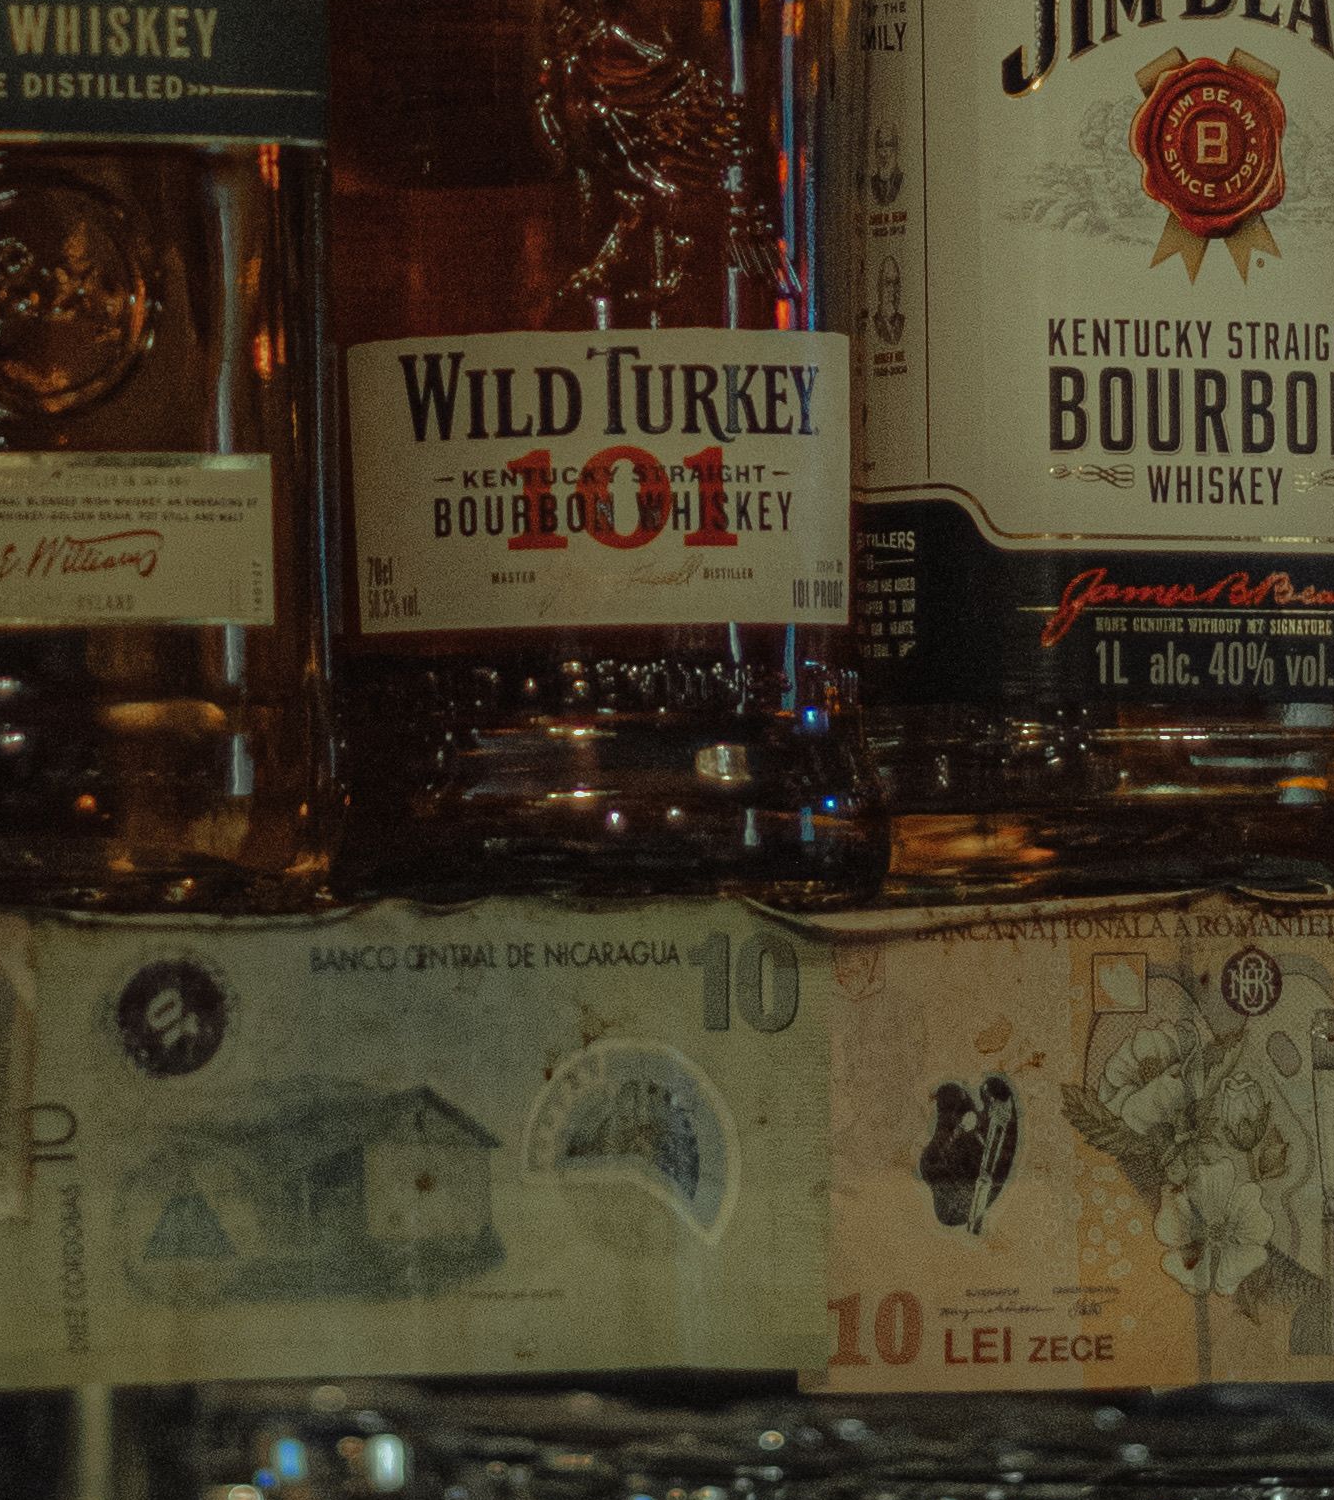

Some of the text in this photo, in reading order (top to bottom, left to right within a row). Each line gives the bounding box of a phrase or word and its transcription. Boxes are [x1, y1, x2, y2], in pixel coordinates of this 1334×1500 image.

[7, 3, 220, 61] WHISKEY
[22, 73, 185, 101] DISTILLED
[1166, 86, 1259, 133] JIM BEAM
[1165, 147, 1261, 199] SINCE 1795
[1046, 317, 1213, 360] KENTUCKY
[398, 345, 821, 444] WILD TURKEY
[462, 463, 767, 488] KENTUCKY STRAIGHT
[505, 444, 739, 551] 101
[1146, 463, 1285, 507] WHISKEY
[433, 491, 794, 538] BOURBON WHISKEY
[1187, 617, 1242, 636] WITHOUT
[1268, 618, 1334, 637] SIGNATURE
[1094, 639, 1130, 687] 1L
[1148, 639, 1201, 688] alc.
[1207, 639, 1276, 688] 40%
[308, 929, 801, 1034] BANCO CENTRAL DE NICARAGUA 10
[825, 1289, 925, 1367] 10
[943, 1325, 1014, 1366] LEI
[1026, 1332, 1117, 1365] ZECE
